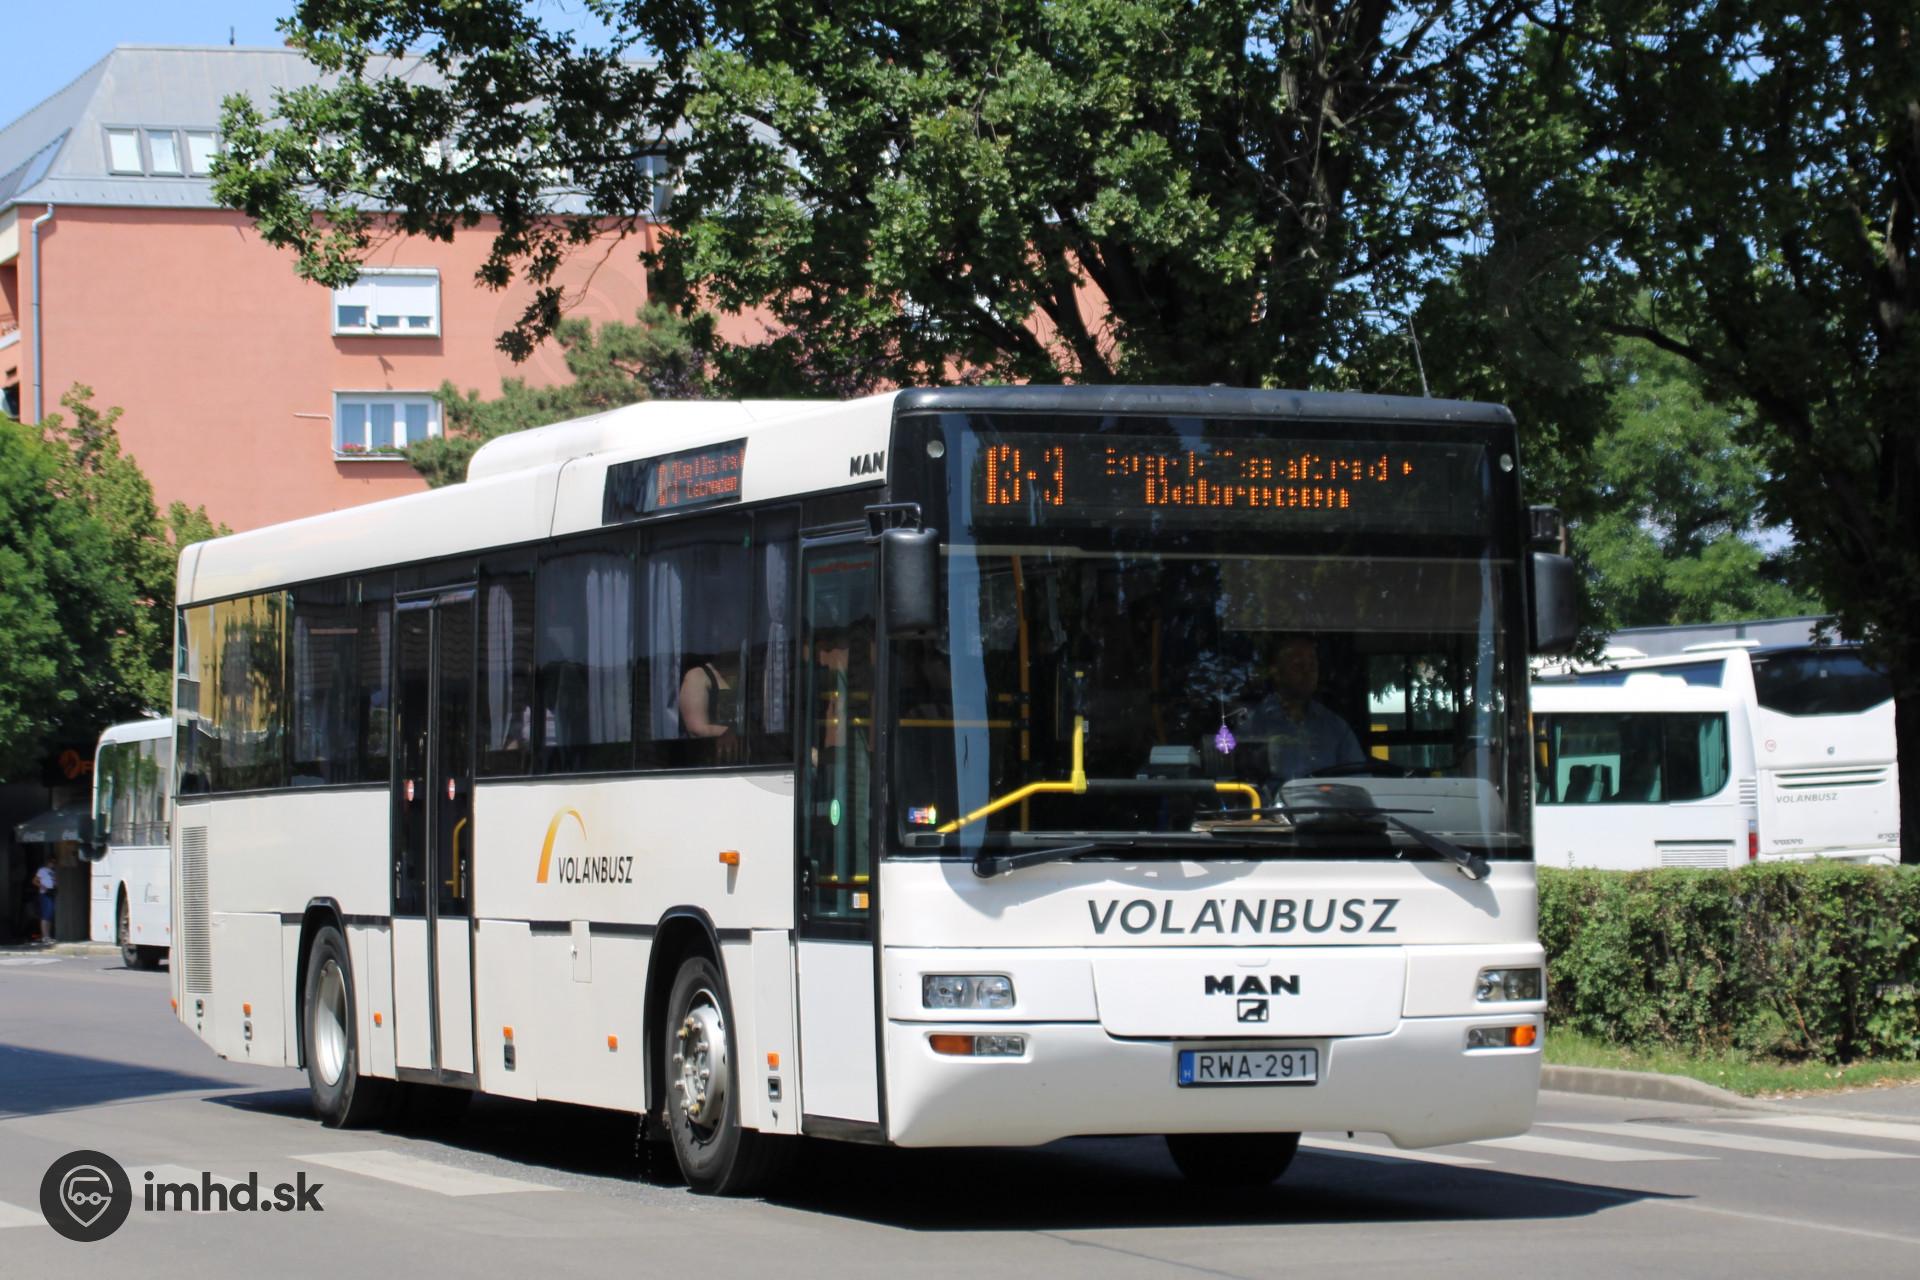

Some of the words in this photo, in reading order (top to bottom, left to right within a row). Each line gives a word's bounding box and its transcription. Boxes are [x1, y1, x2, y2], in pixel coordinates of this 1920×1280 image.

[850, 451, 885, 477] MAN
[1204, 975, 1300, 995] MAN
[1199, 1054, 1308, 1078] RWA-291
